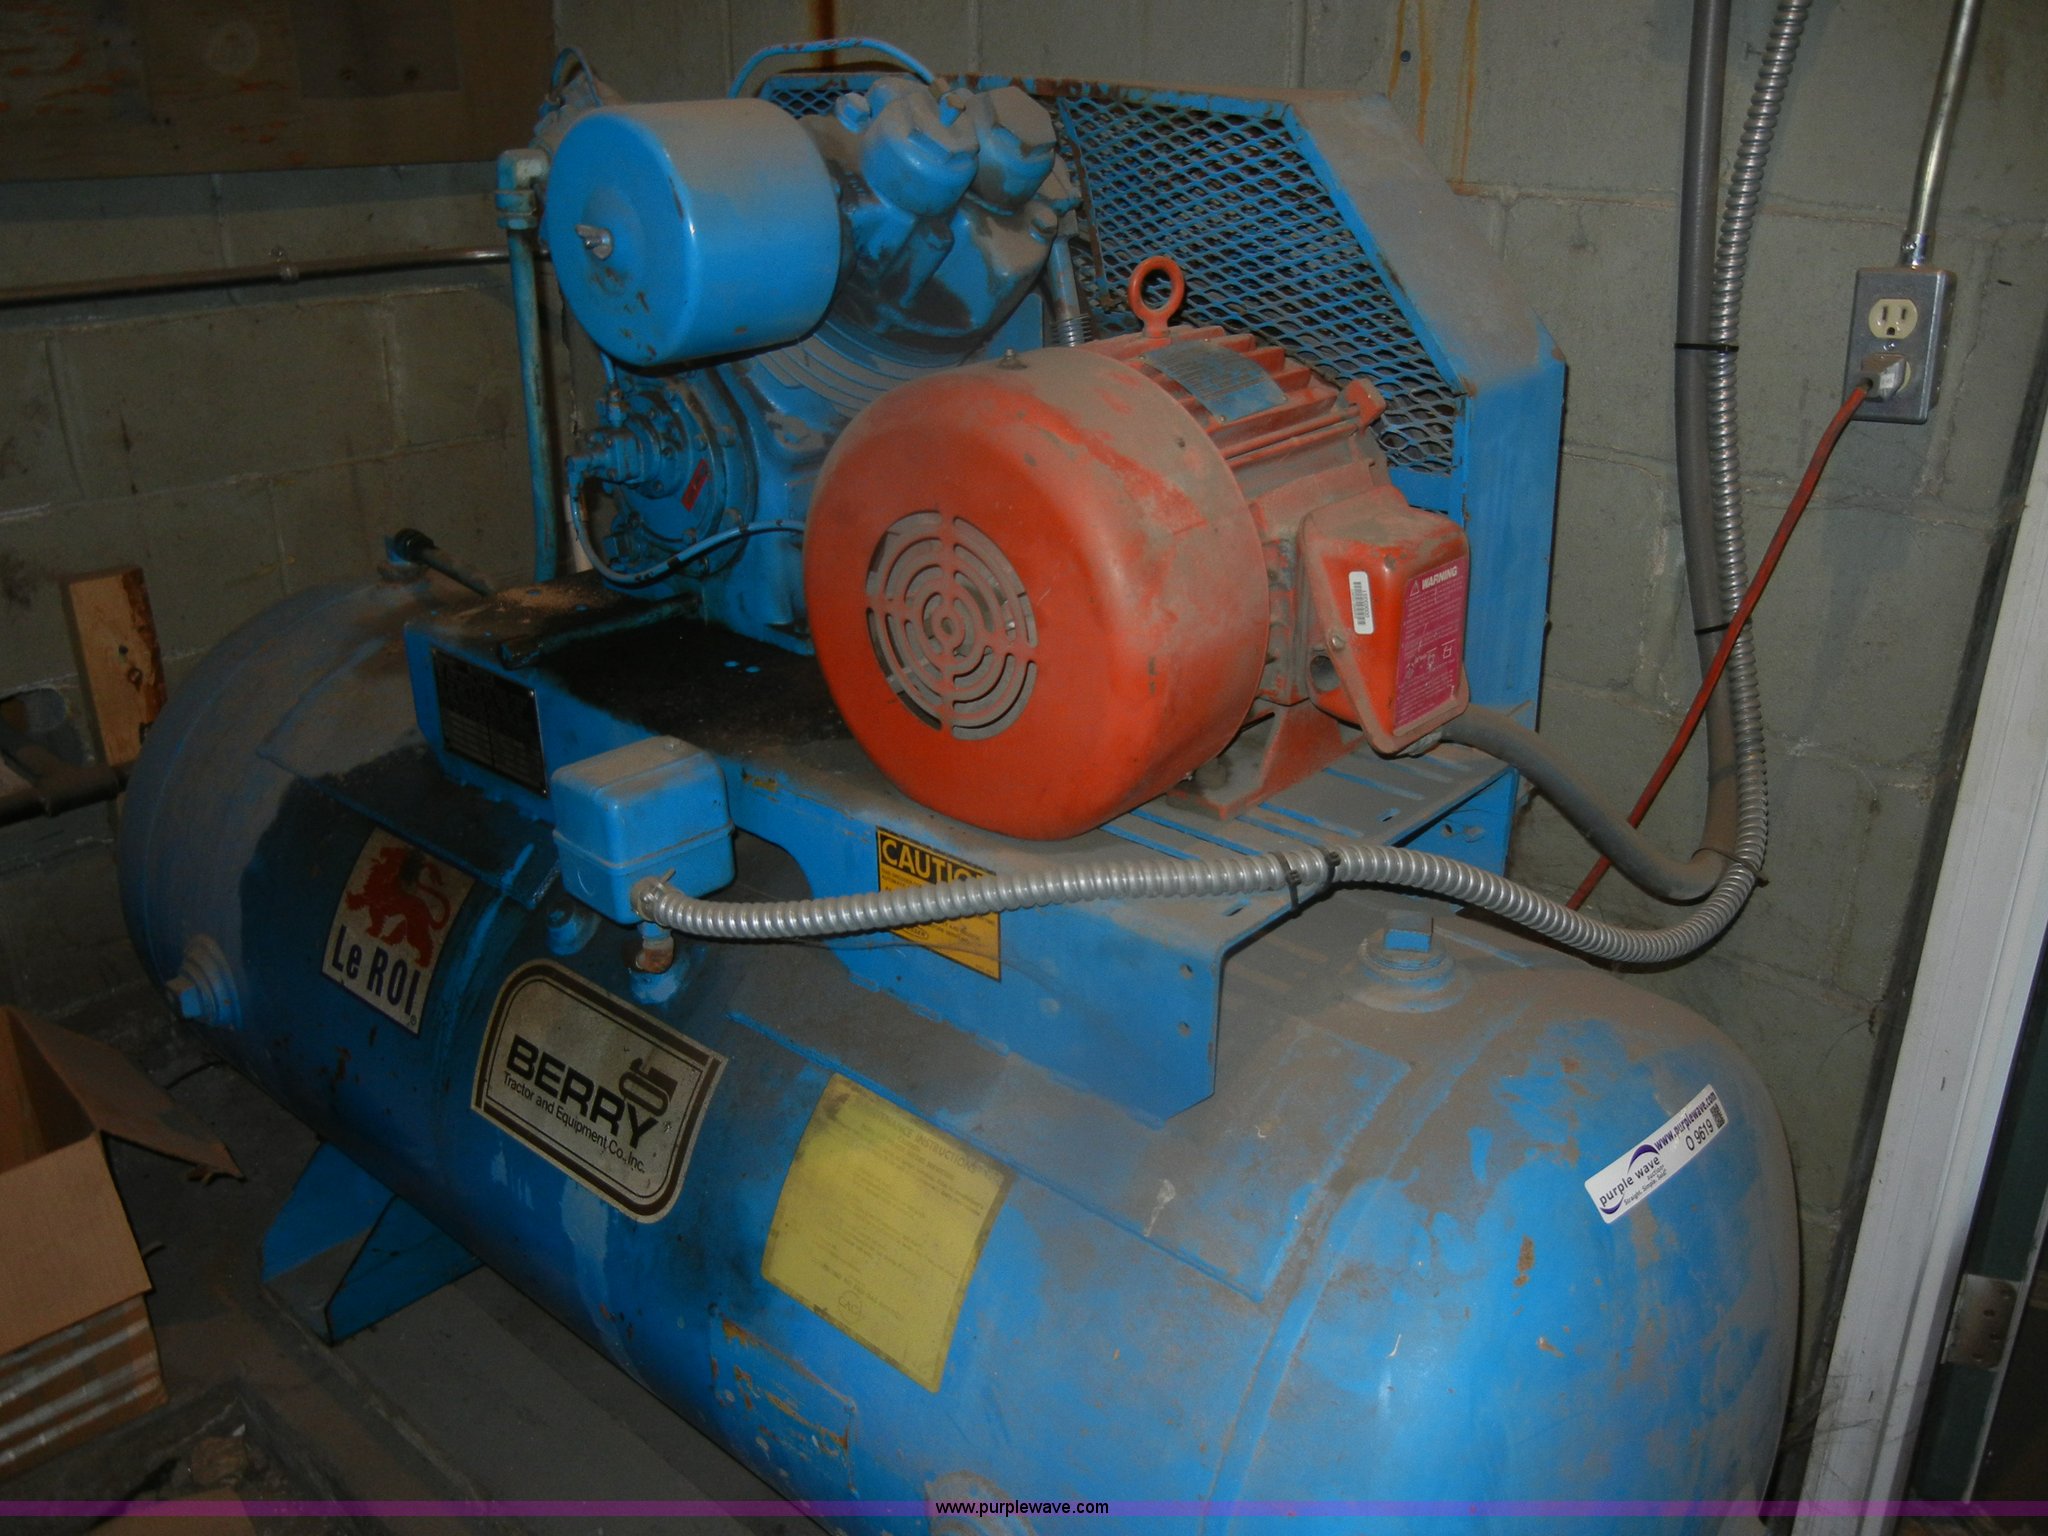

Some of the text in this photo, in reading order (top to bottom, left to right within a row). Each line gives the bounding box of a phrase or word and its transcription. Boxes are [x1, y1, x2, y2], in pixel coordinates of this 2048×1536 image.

[1422, 565, 1458, 590] WARNING
[882, 838, 983, 885] CAUTI
[332, 924, 420, 1016] Le ROI
[503, 1071, 534, 1101] Tractor
[536, 1094, 555, 1115] and
[556, 1105, 608, 1149] Equipment
[506, 1034, 659, 1149] BERRY
[1654, 1091, 1718, 1151] www.purplewave.com
[1694, 1118, 1714, 1145] 9619
[1599, 1154, 1661, 1208] purple wave
